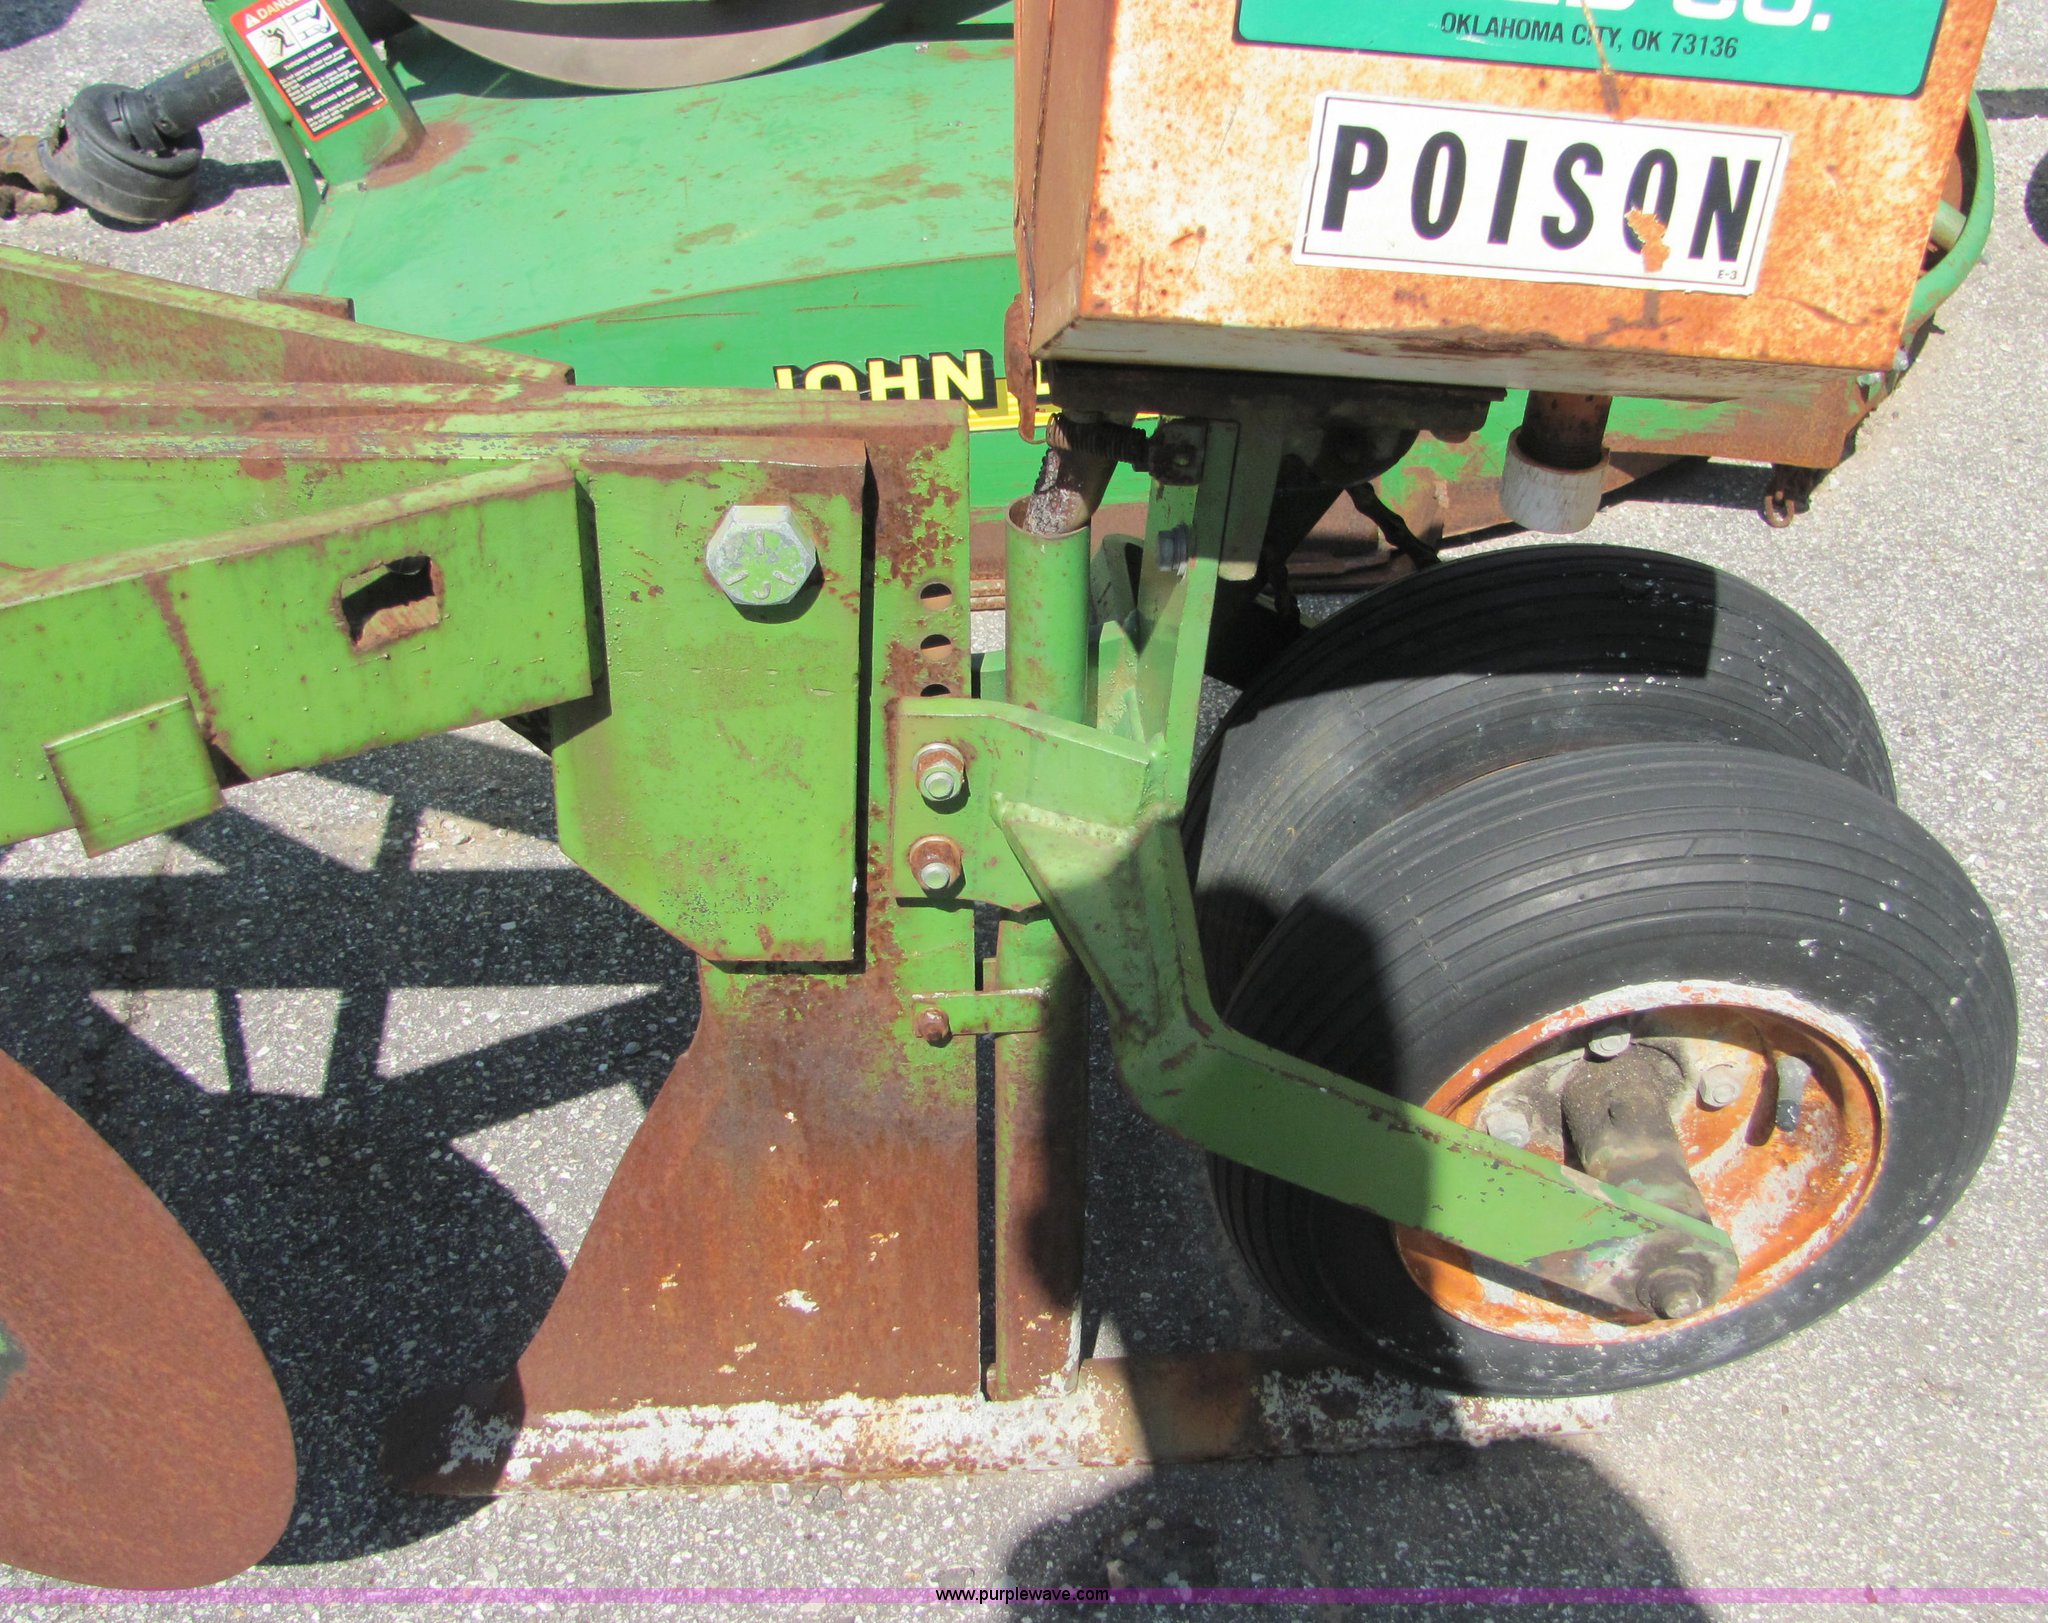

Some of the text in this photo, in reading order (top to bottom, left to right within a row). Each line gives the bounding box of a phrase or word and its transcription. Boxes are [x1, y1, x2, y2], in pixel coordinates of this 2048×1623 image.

[1441, 12, 1564, 43] OKLAHOMA
[1632, 29, 1662, 52] OK
[1672, 32, 1739, 59] 73136
[1321, 124, 1761, 263] POISON
[1717, 269, 1738, 280] E-3
